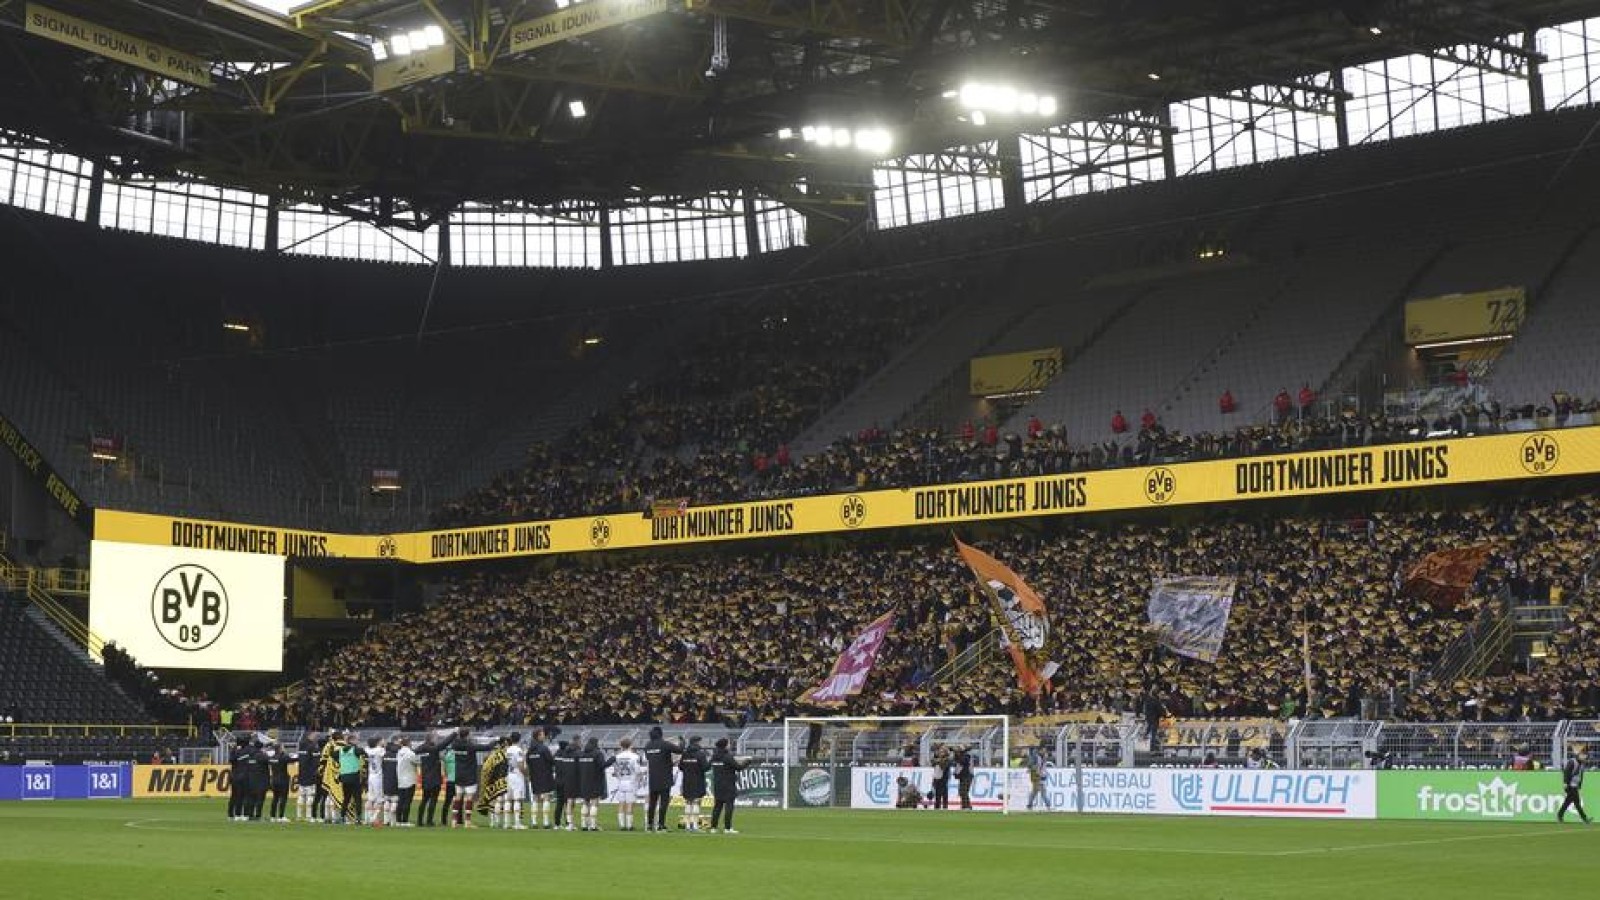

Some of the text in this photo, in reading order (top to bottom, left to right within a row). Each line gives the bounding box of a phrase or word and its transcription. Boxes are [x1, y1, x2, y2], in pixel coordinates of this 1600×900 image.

[32, 13, 89, 42] SIGNAL
[93, 32, 139, 57] IDUNA
[514, 20, 558, 44] SIGNAL
[1487, 299, 1518, 324] 72
[1032, 358, 1058, 381] 73
[1525, 437, 1556, 463] BVB
[1148, 470, 1174, 494] BVB
[1236, 445, 1449, 494] DORTMUNDER JUNGS
[843, 497, 864, 519] BVB
[915, 477, 1087, 520] DORTMUNDER JUNGS
[651, 503, 794, 541] DORTMUNDER JUNGS
[172, 520, 328, 557] DORTMUNDER JUNGS
[431, 523, 551, 558] DORTMUNDER JUNGS
[162, 572, 221, 626] BVB
[179, 624, 201, 643] 09
[26, 773, 51, 790] 1&1
[91, 772, 118, 790] 1&1
[147, 768, 233, 793] Mit PO
[1045, 771, 1151, 789] NLAGENBAU
[1211, 774, 1350, 804] ULLRICH
